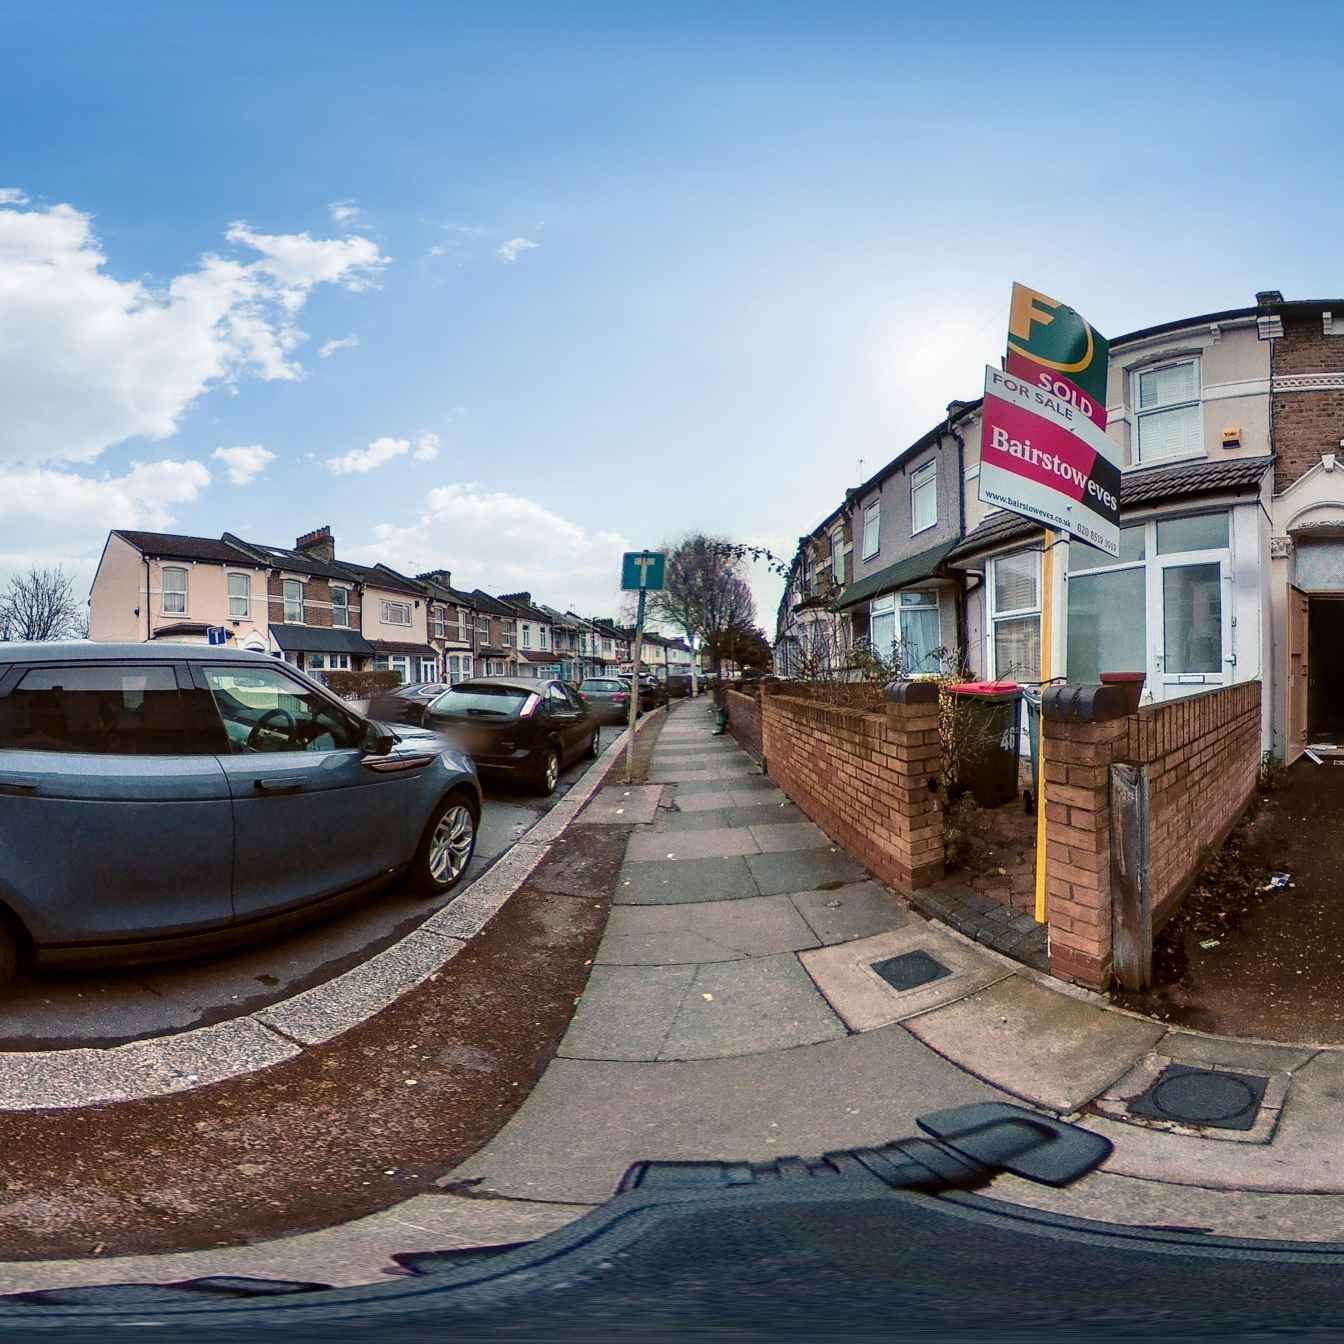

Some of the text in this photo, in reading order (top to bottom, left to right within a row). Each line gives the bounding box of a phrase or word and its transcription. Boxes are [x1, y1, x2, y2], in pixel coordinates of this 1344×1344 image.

[992, 373, 1074, 421] FOR SALE
[1038, 372, 1093, 418] SOLD
[1077, 523, 1090, 537] 020
